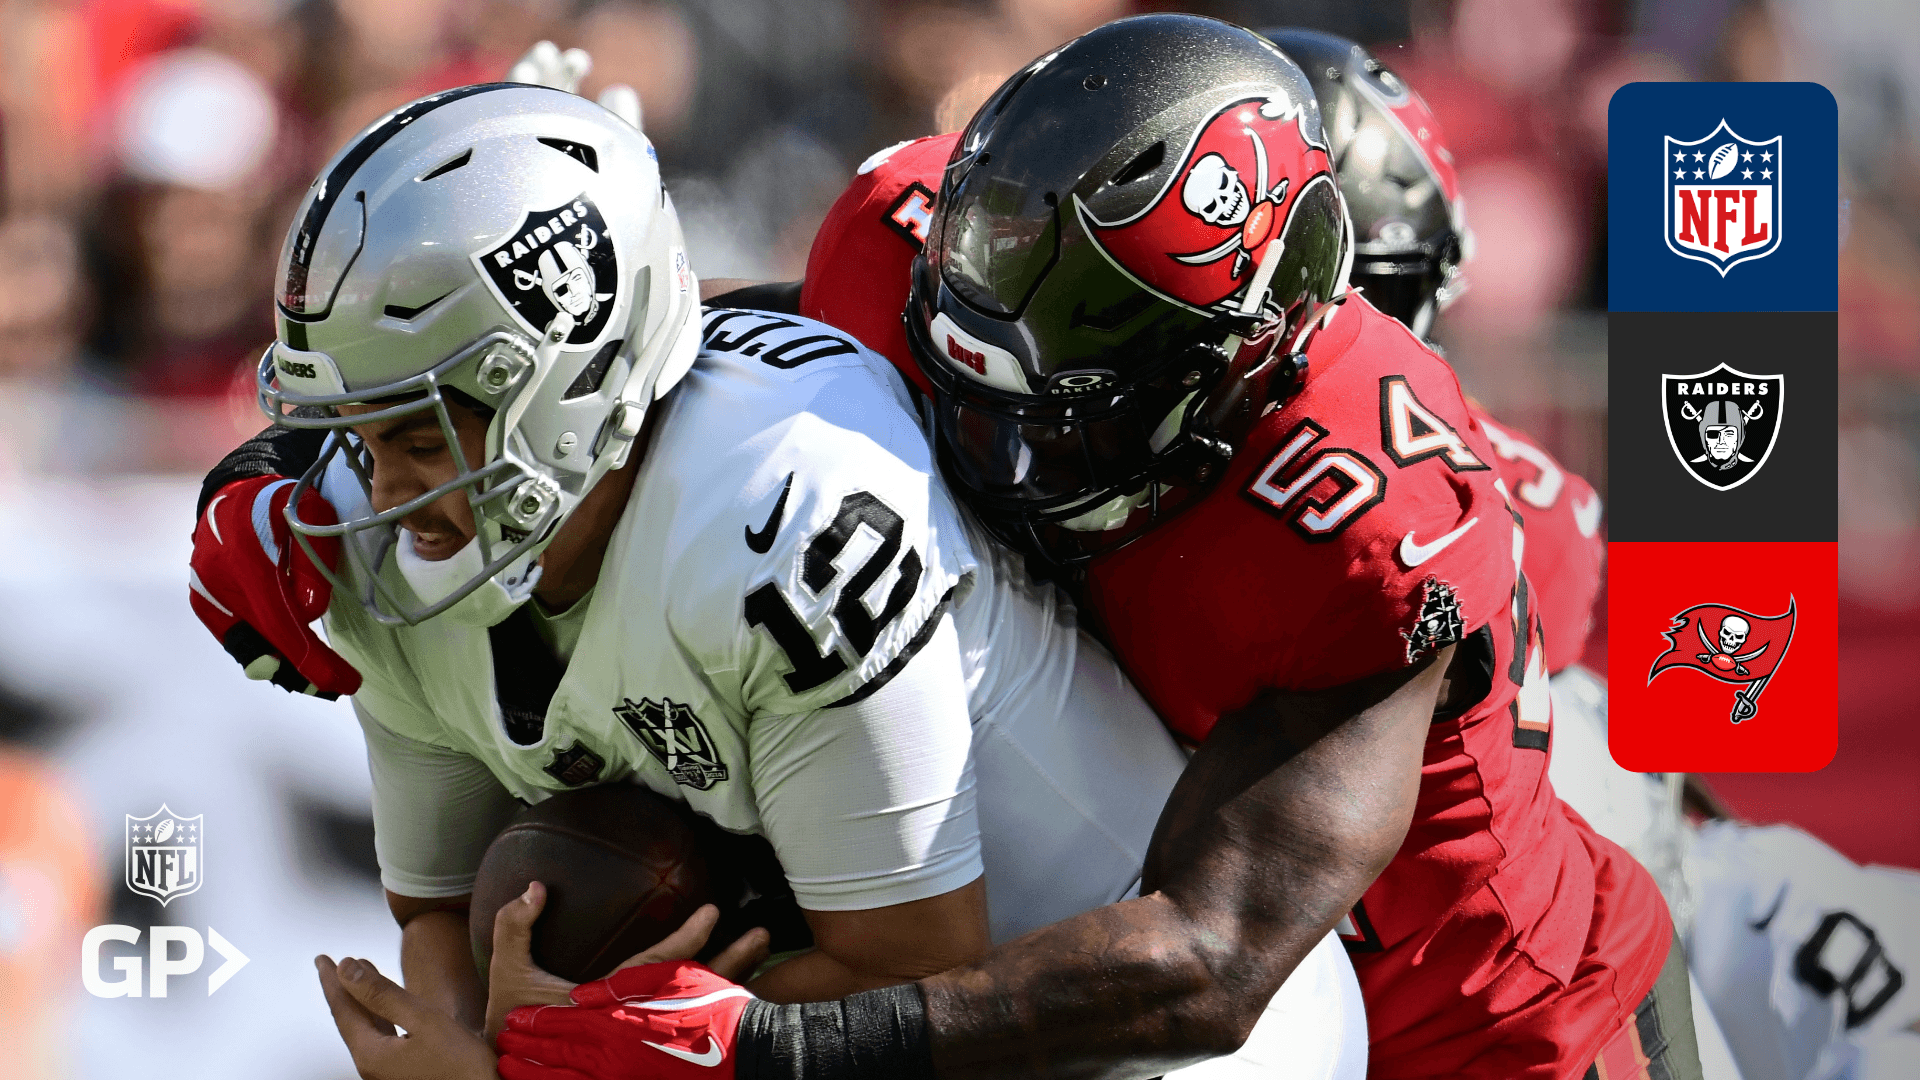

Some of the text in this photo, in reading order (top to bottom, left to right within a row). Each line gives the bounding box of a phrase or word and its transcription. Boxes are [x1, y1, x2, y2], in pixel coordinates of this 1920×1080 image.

[494, 200, 588, 268] RAIDERS
[1051, 380, 1114, 395] OAKLEY
[1238, 374, 1492, 544] 54
[743, 490, 924, 696] 12
